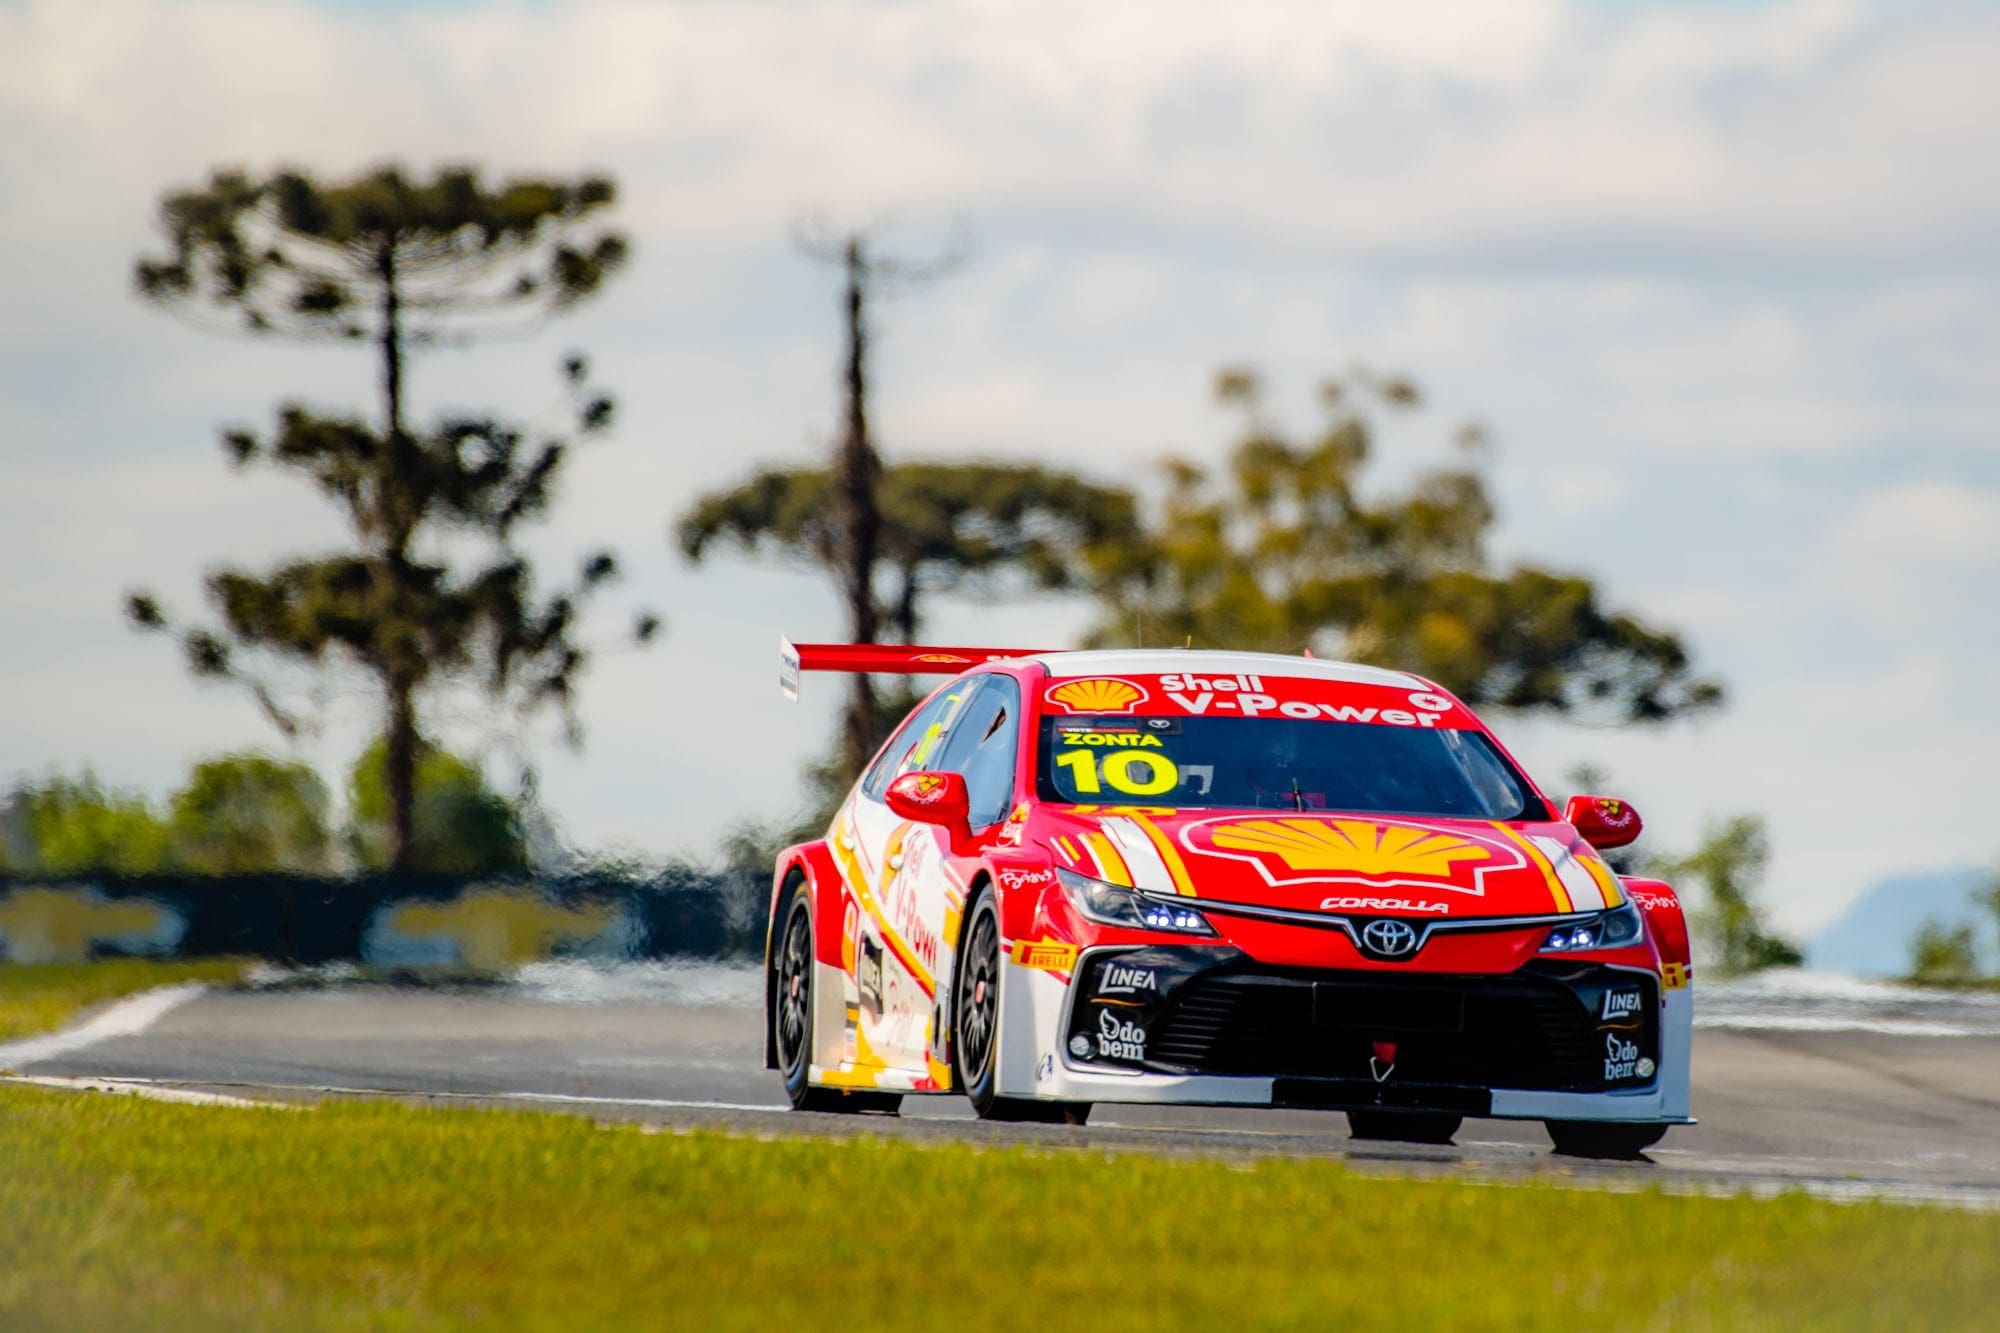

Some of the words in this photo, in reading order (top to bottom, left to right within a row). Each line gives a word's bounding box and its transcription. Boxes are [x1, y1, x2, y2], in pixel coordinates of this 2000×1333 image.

[1159, 673, 1264, 692] Shell
[1166, 692, 1441, 727] V-Power
[1062, 732, 1163, 747] ZONTA
[1056, 748, 1179, 796] 10
[1320, 897, 1449, 914] COROLLA
[1098, 963, 1157, 994] LINEA
[1602, 989, 1643, 1020] LINEA
[1119, 1021, 1145, 1044] do
[1097, 1032, 1145, 1061] bem
[1621, 1041, 1638, 1061] do
